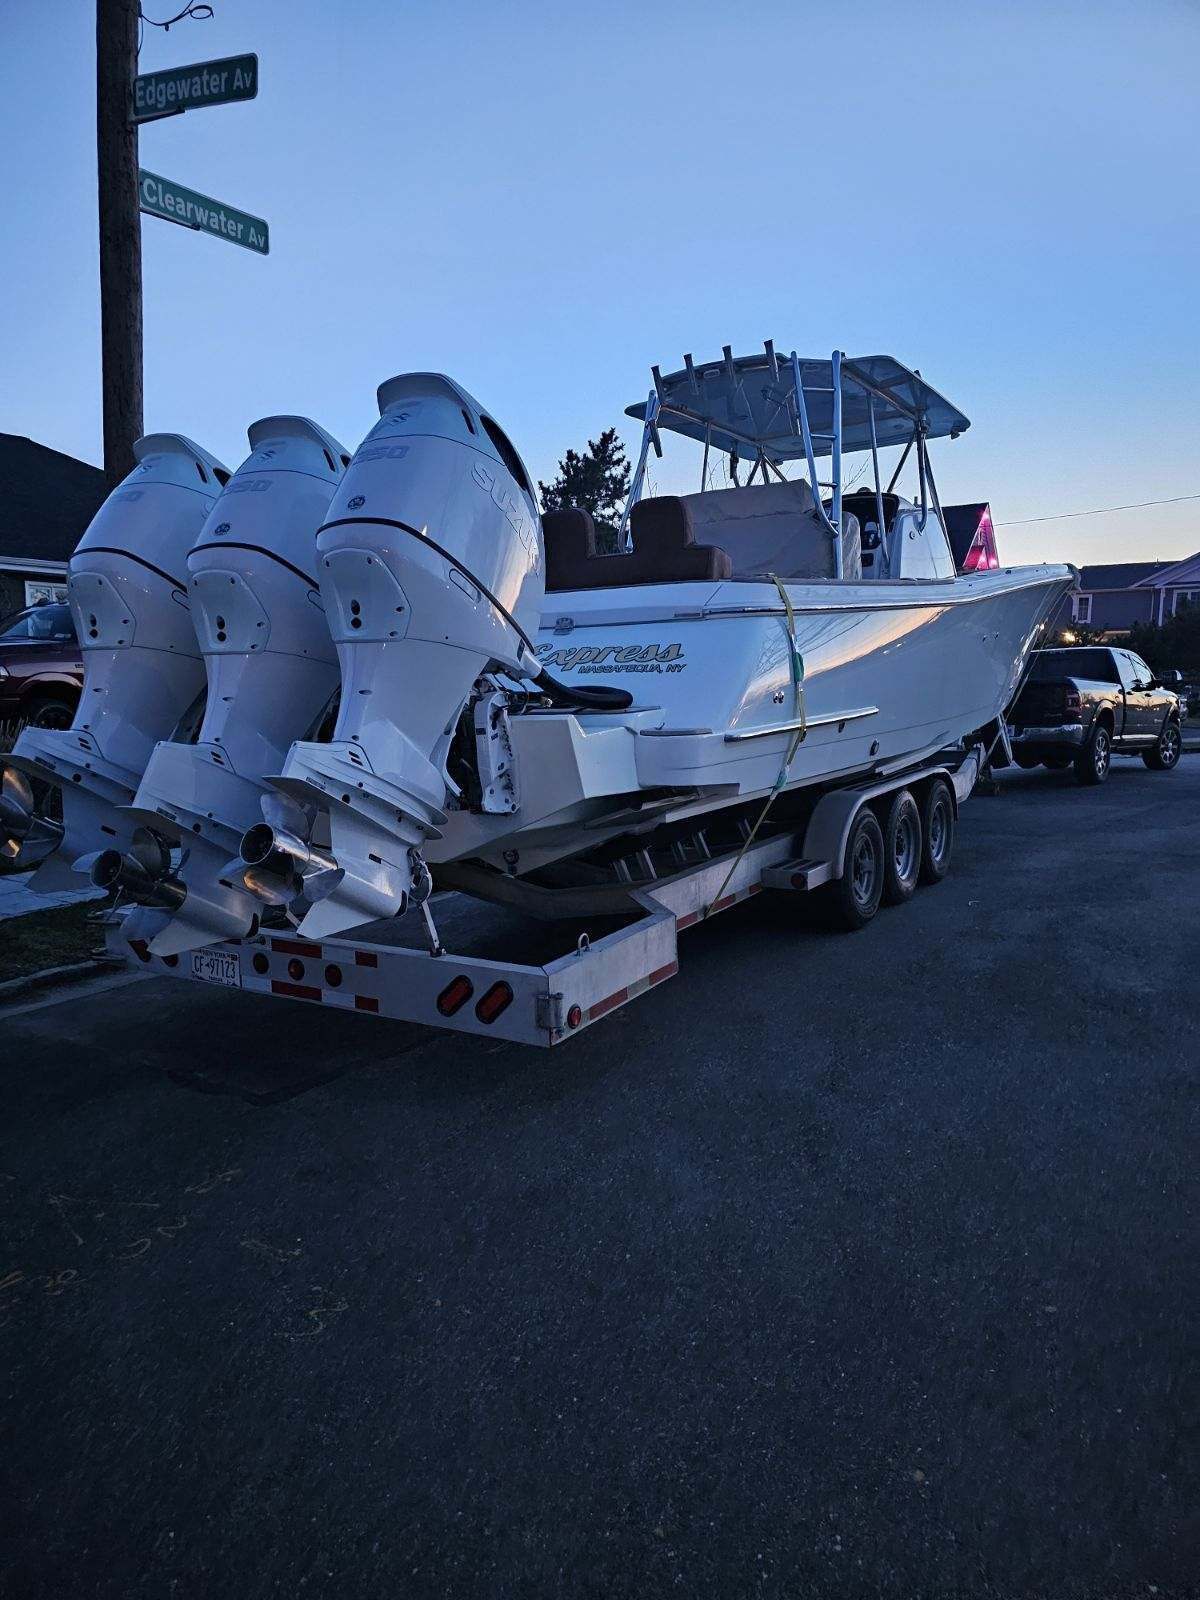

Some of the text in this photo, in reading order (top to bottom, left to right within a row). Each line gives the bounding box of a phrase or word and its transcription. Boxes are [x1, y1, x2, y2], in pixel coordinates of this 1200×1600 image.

[135, 68, 253, 108] Edgewater Av
[142, 178, 266, 248] Clearwater Av
[534, 643, 685, 672] Express
[665, 663, 687, 673] NY
